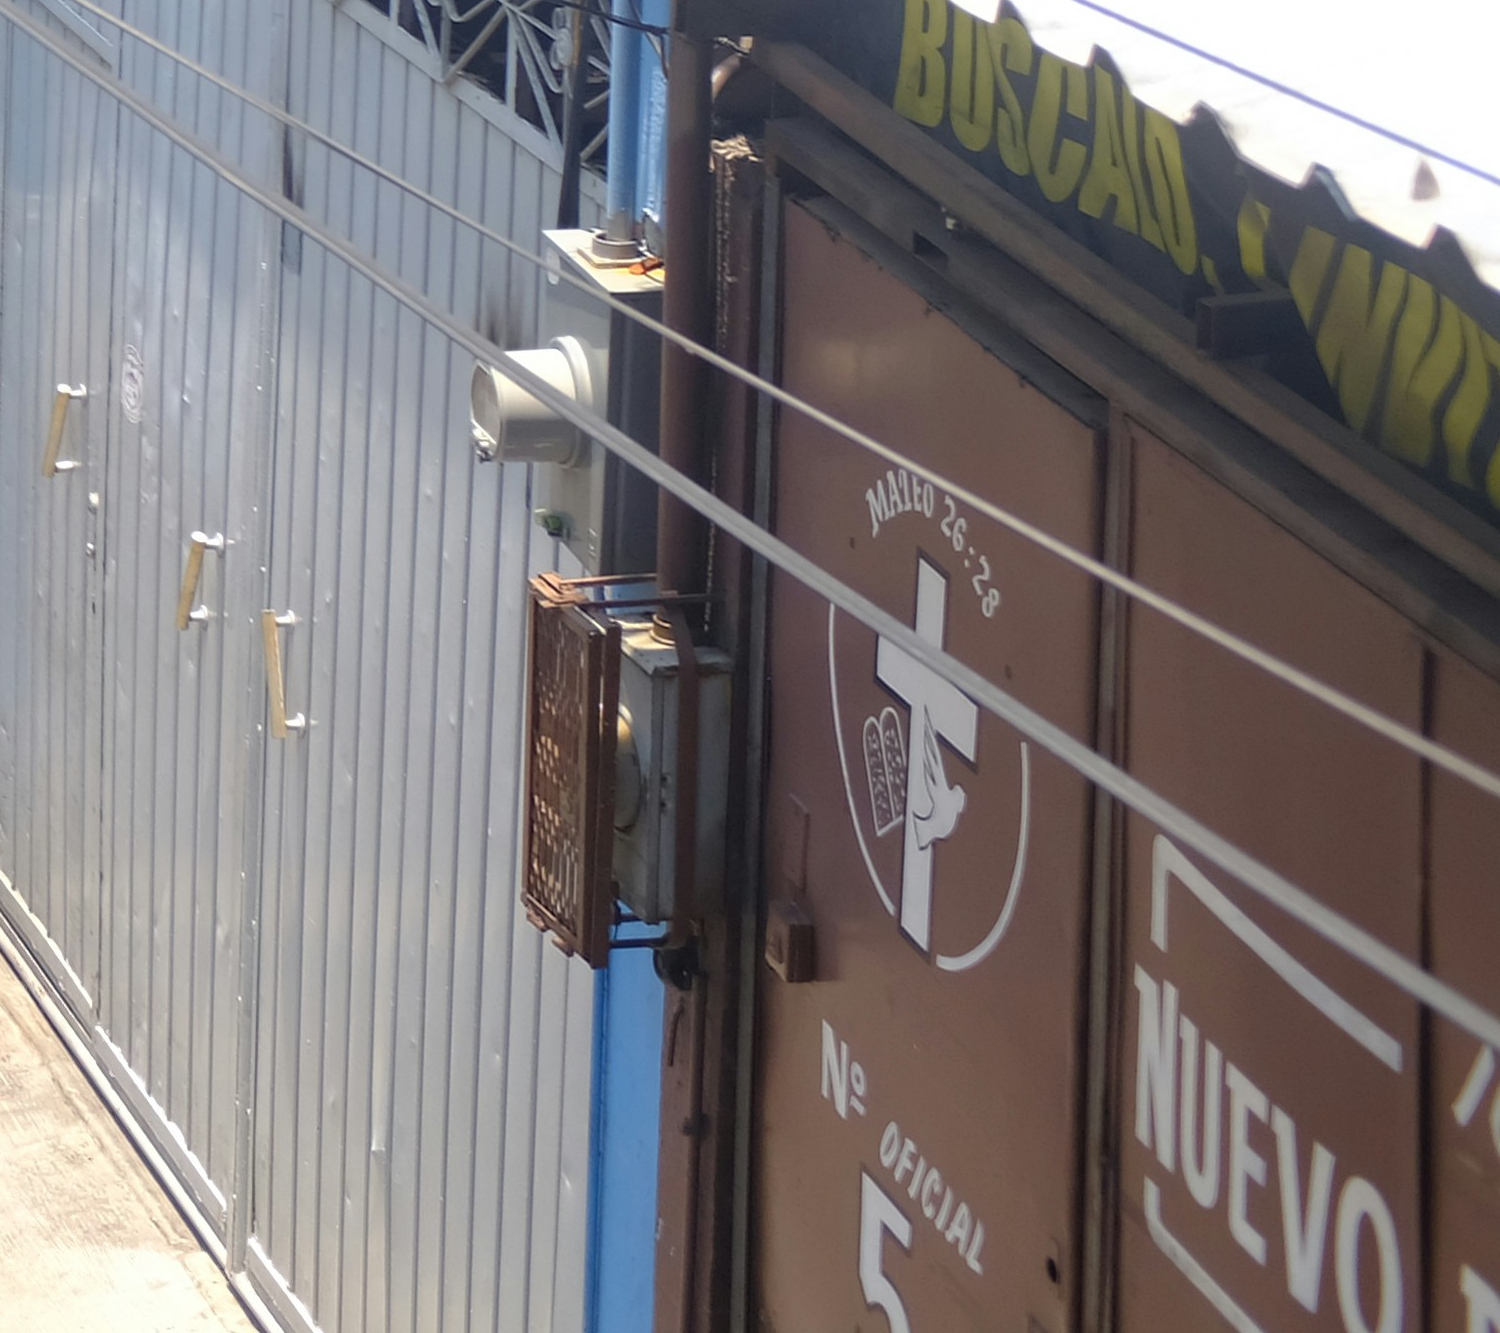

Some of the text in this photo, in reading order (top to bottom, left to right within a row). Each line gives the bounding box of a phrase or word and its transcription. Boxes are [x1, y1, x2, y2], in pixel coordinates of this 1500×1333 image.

[864, 469, 934, 539] MATEO
[879, 1120, 986, 1277] OFICIAL
[1132, 963, 1404, 1333] NUEVO
[858, 1170, 913, 1333] 5
